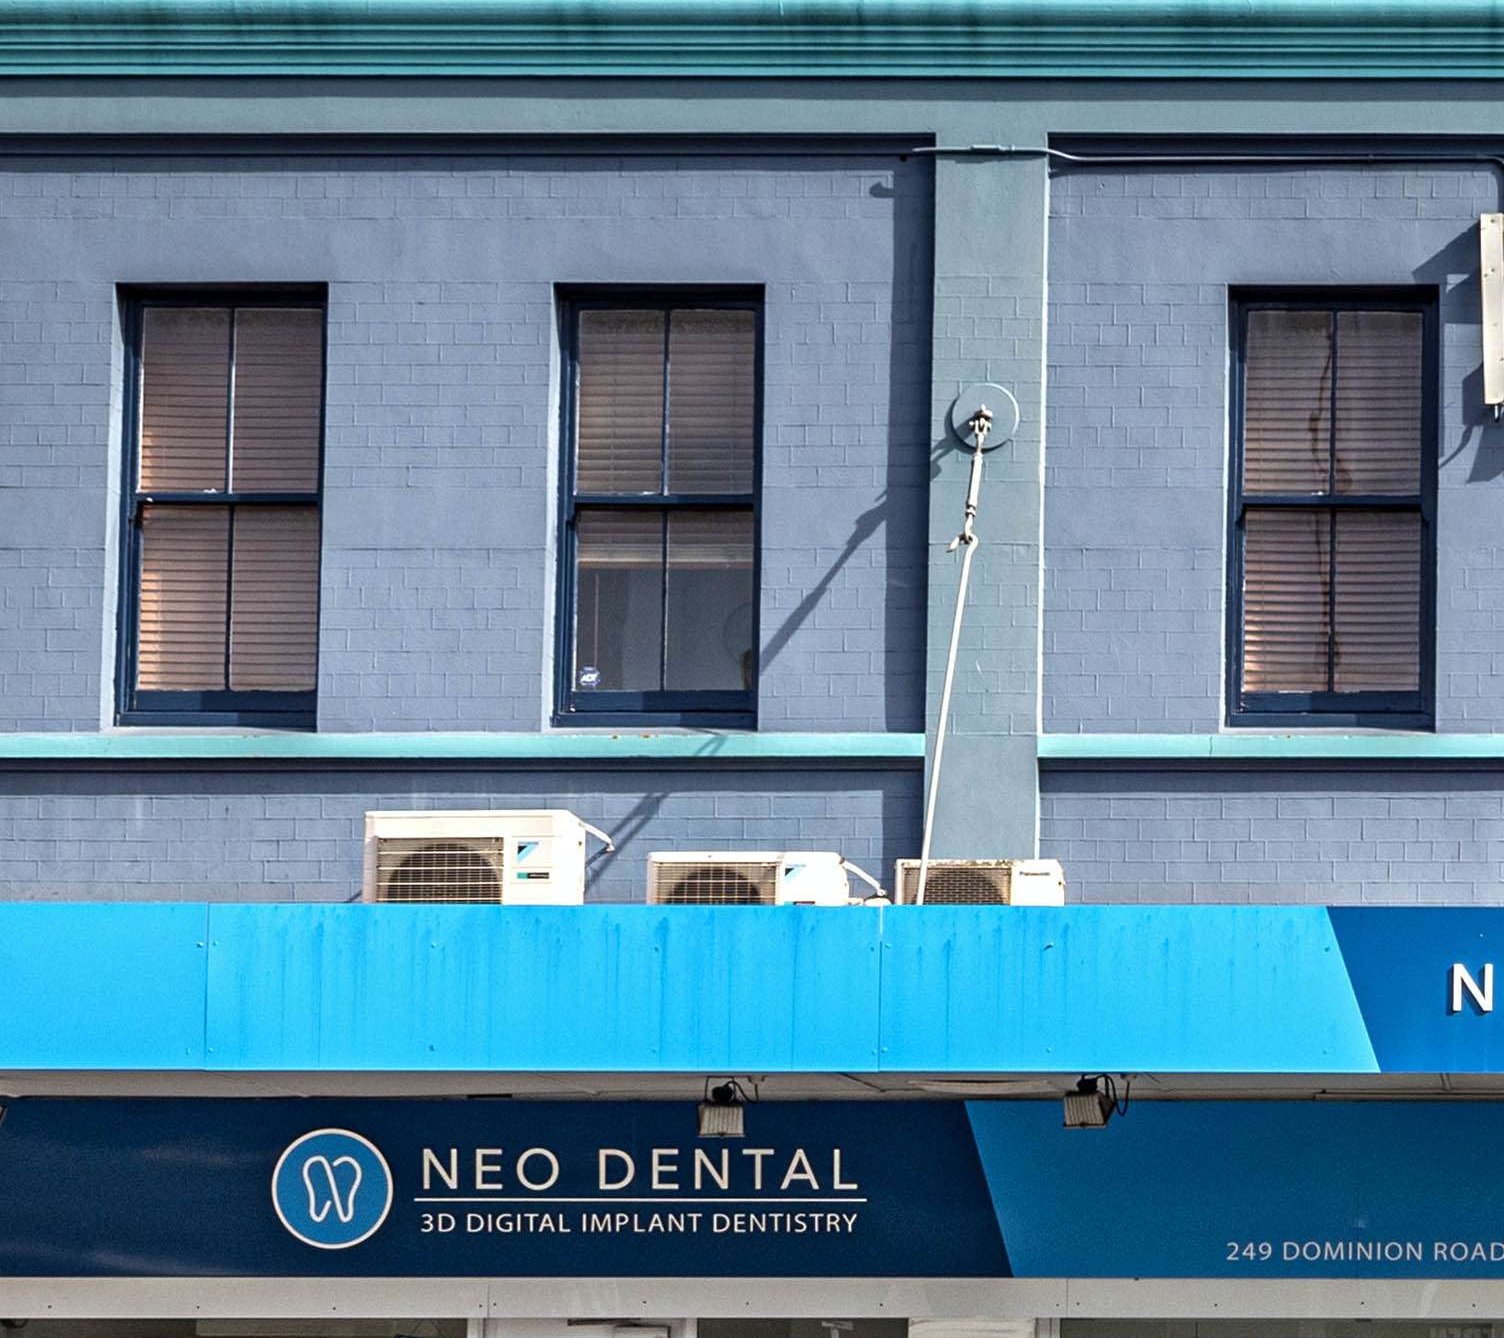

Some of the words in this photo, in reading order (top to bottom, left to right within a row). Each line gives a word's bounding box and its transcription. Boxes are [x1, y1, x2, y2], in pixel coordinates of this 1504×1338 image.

[422, 1148, 560, 1191] NEO
[599, 1148, 858, 1191] DENTAL
[421, 1213, 456, 1233] 3D
[466, 1213, 571, 1233] DIGITAL
[582, 1213, 702, 1233] IMPLANT
[713, 1213, 858, 1233] DENTISTRY
[1226, 1242, 1272, 1262] 249
[1282, 1242, 1423, 1261] DOMINION
